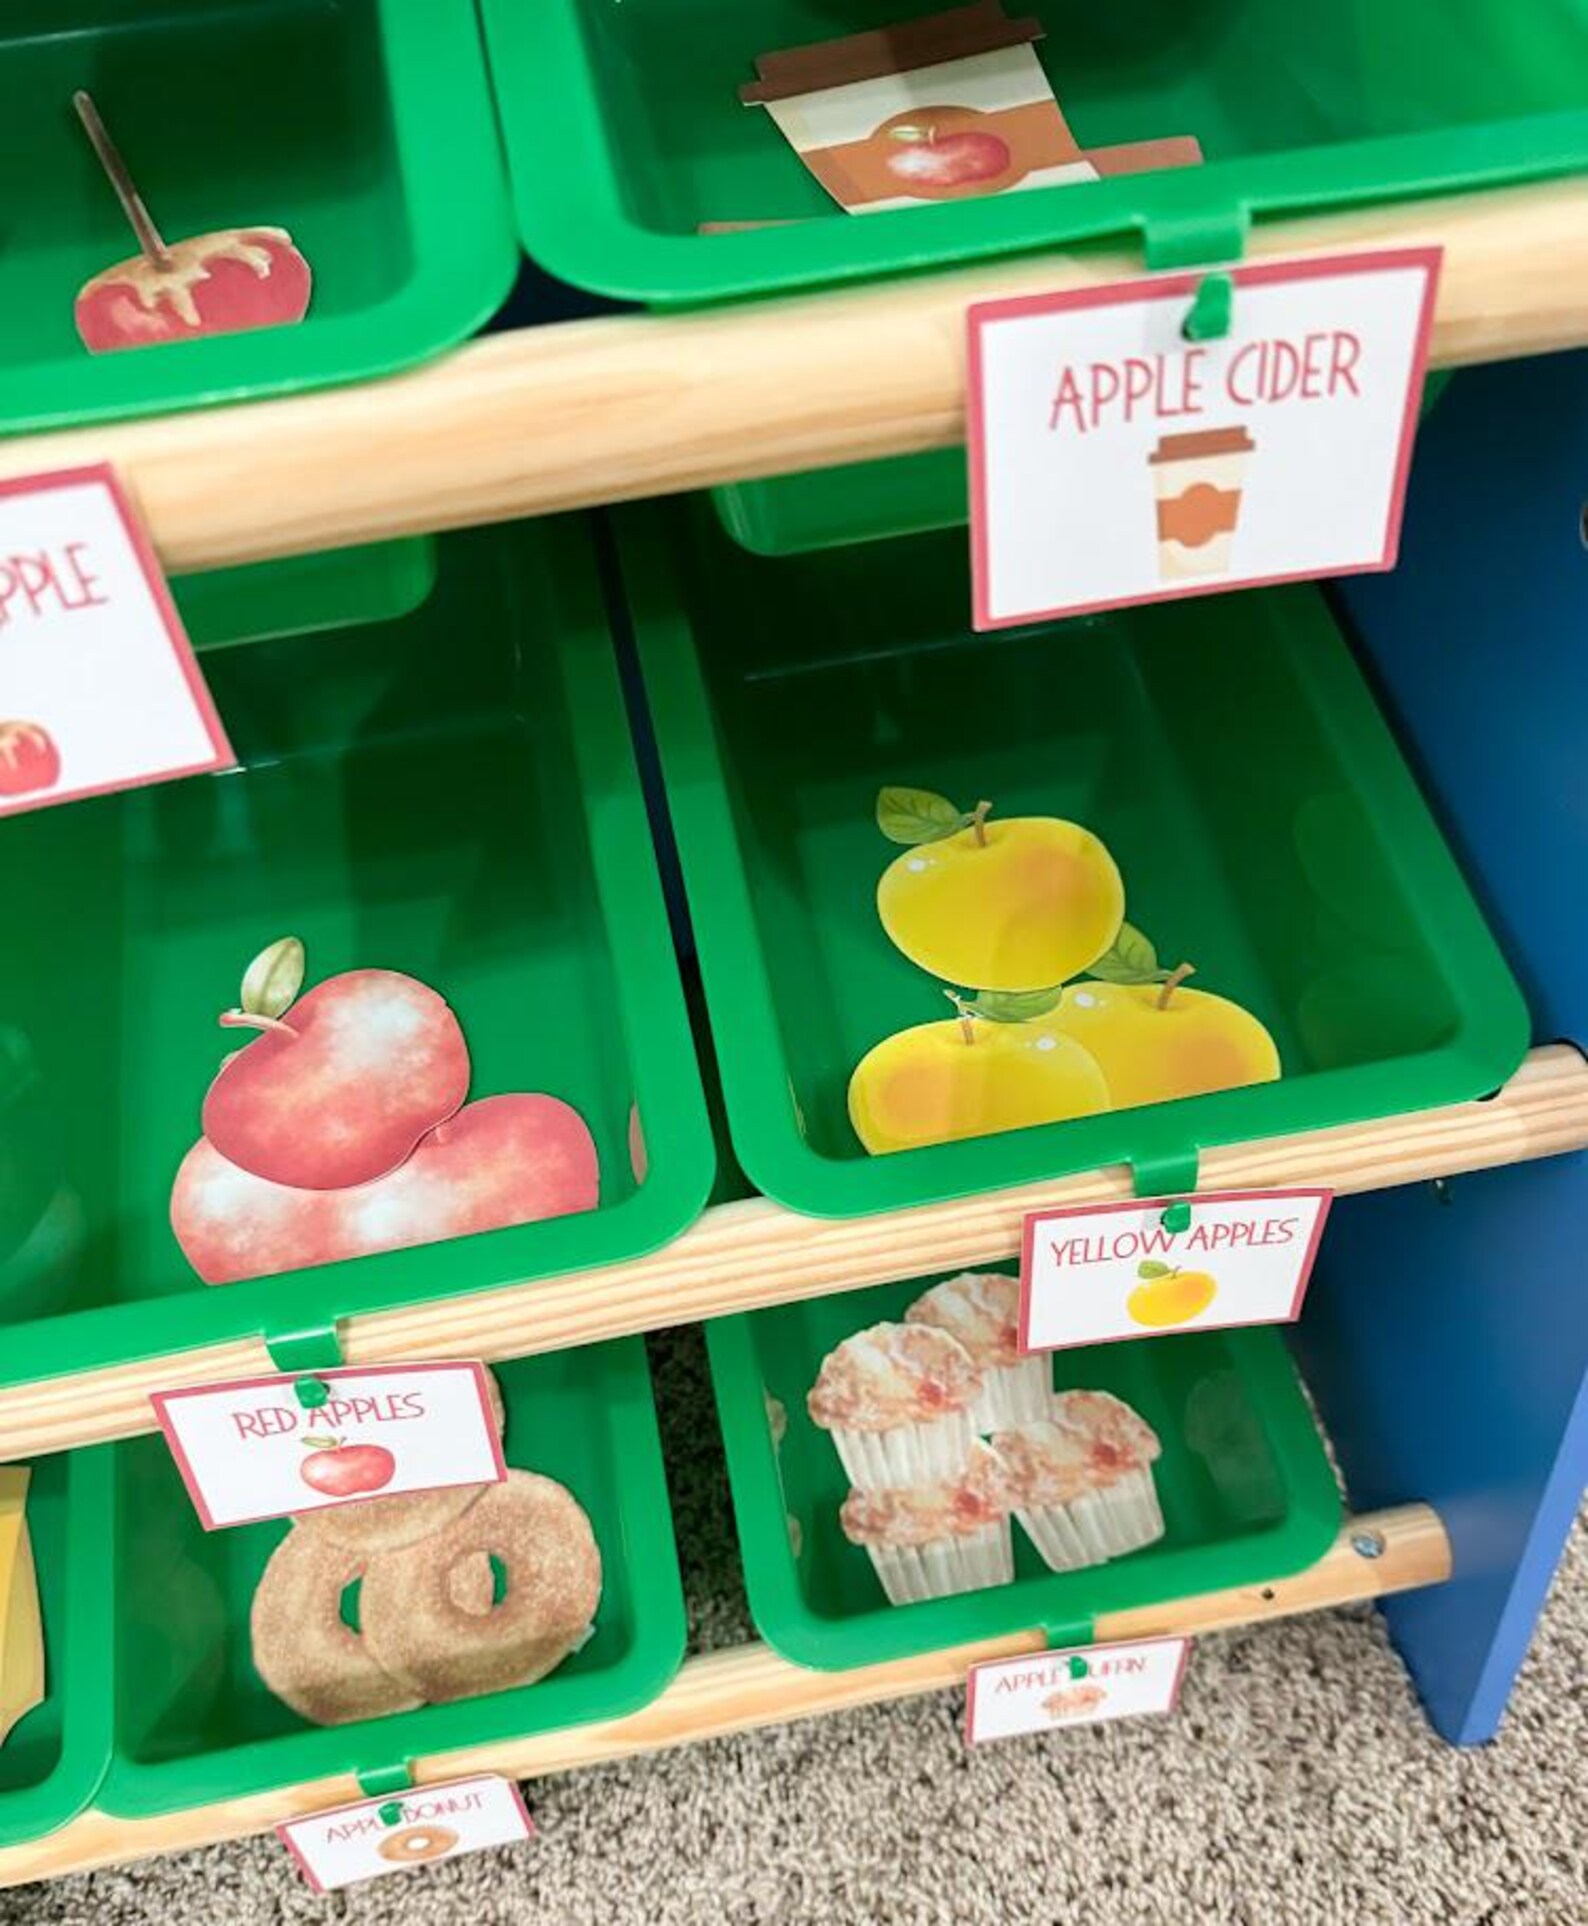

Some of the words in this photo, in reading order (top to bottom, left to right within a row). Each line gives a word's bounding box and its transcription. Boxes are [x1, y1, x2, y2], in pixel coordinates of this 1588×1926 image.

[1050, 348, 1206, 432] APPLE
[1226, 331, 1361, 406] CIDER
[0, 541, 109, 628] PPLE
[1050, 1229, 1176, 1267] YELLOW
[1186, 1217, 1300, 1251] APPLES
[232, 1406, 298, 1439] RED
[308, 1392, 425, 1429] APPLES
[995, 1665, 1062, 1695] APPLE
[1074, 1656, 1146, 1679] UFFIN
[326, 1815, 388, 1844] APPL
[402, 1793, 483, 1825] DONUT
